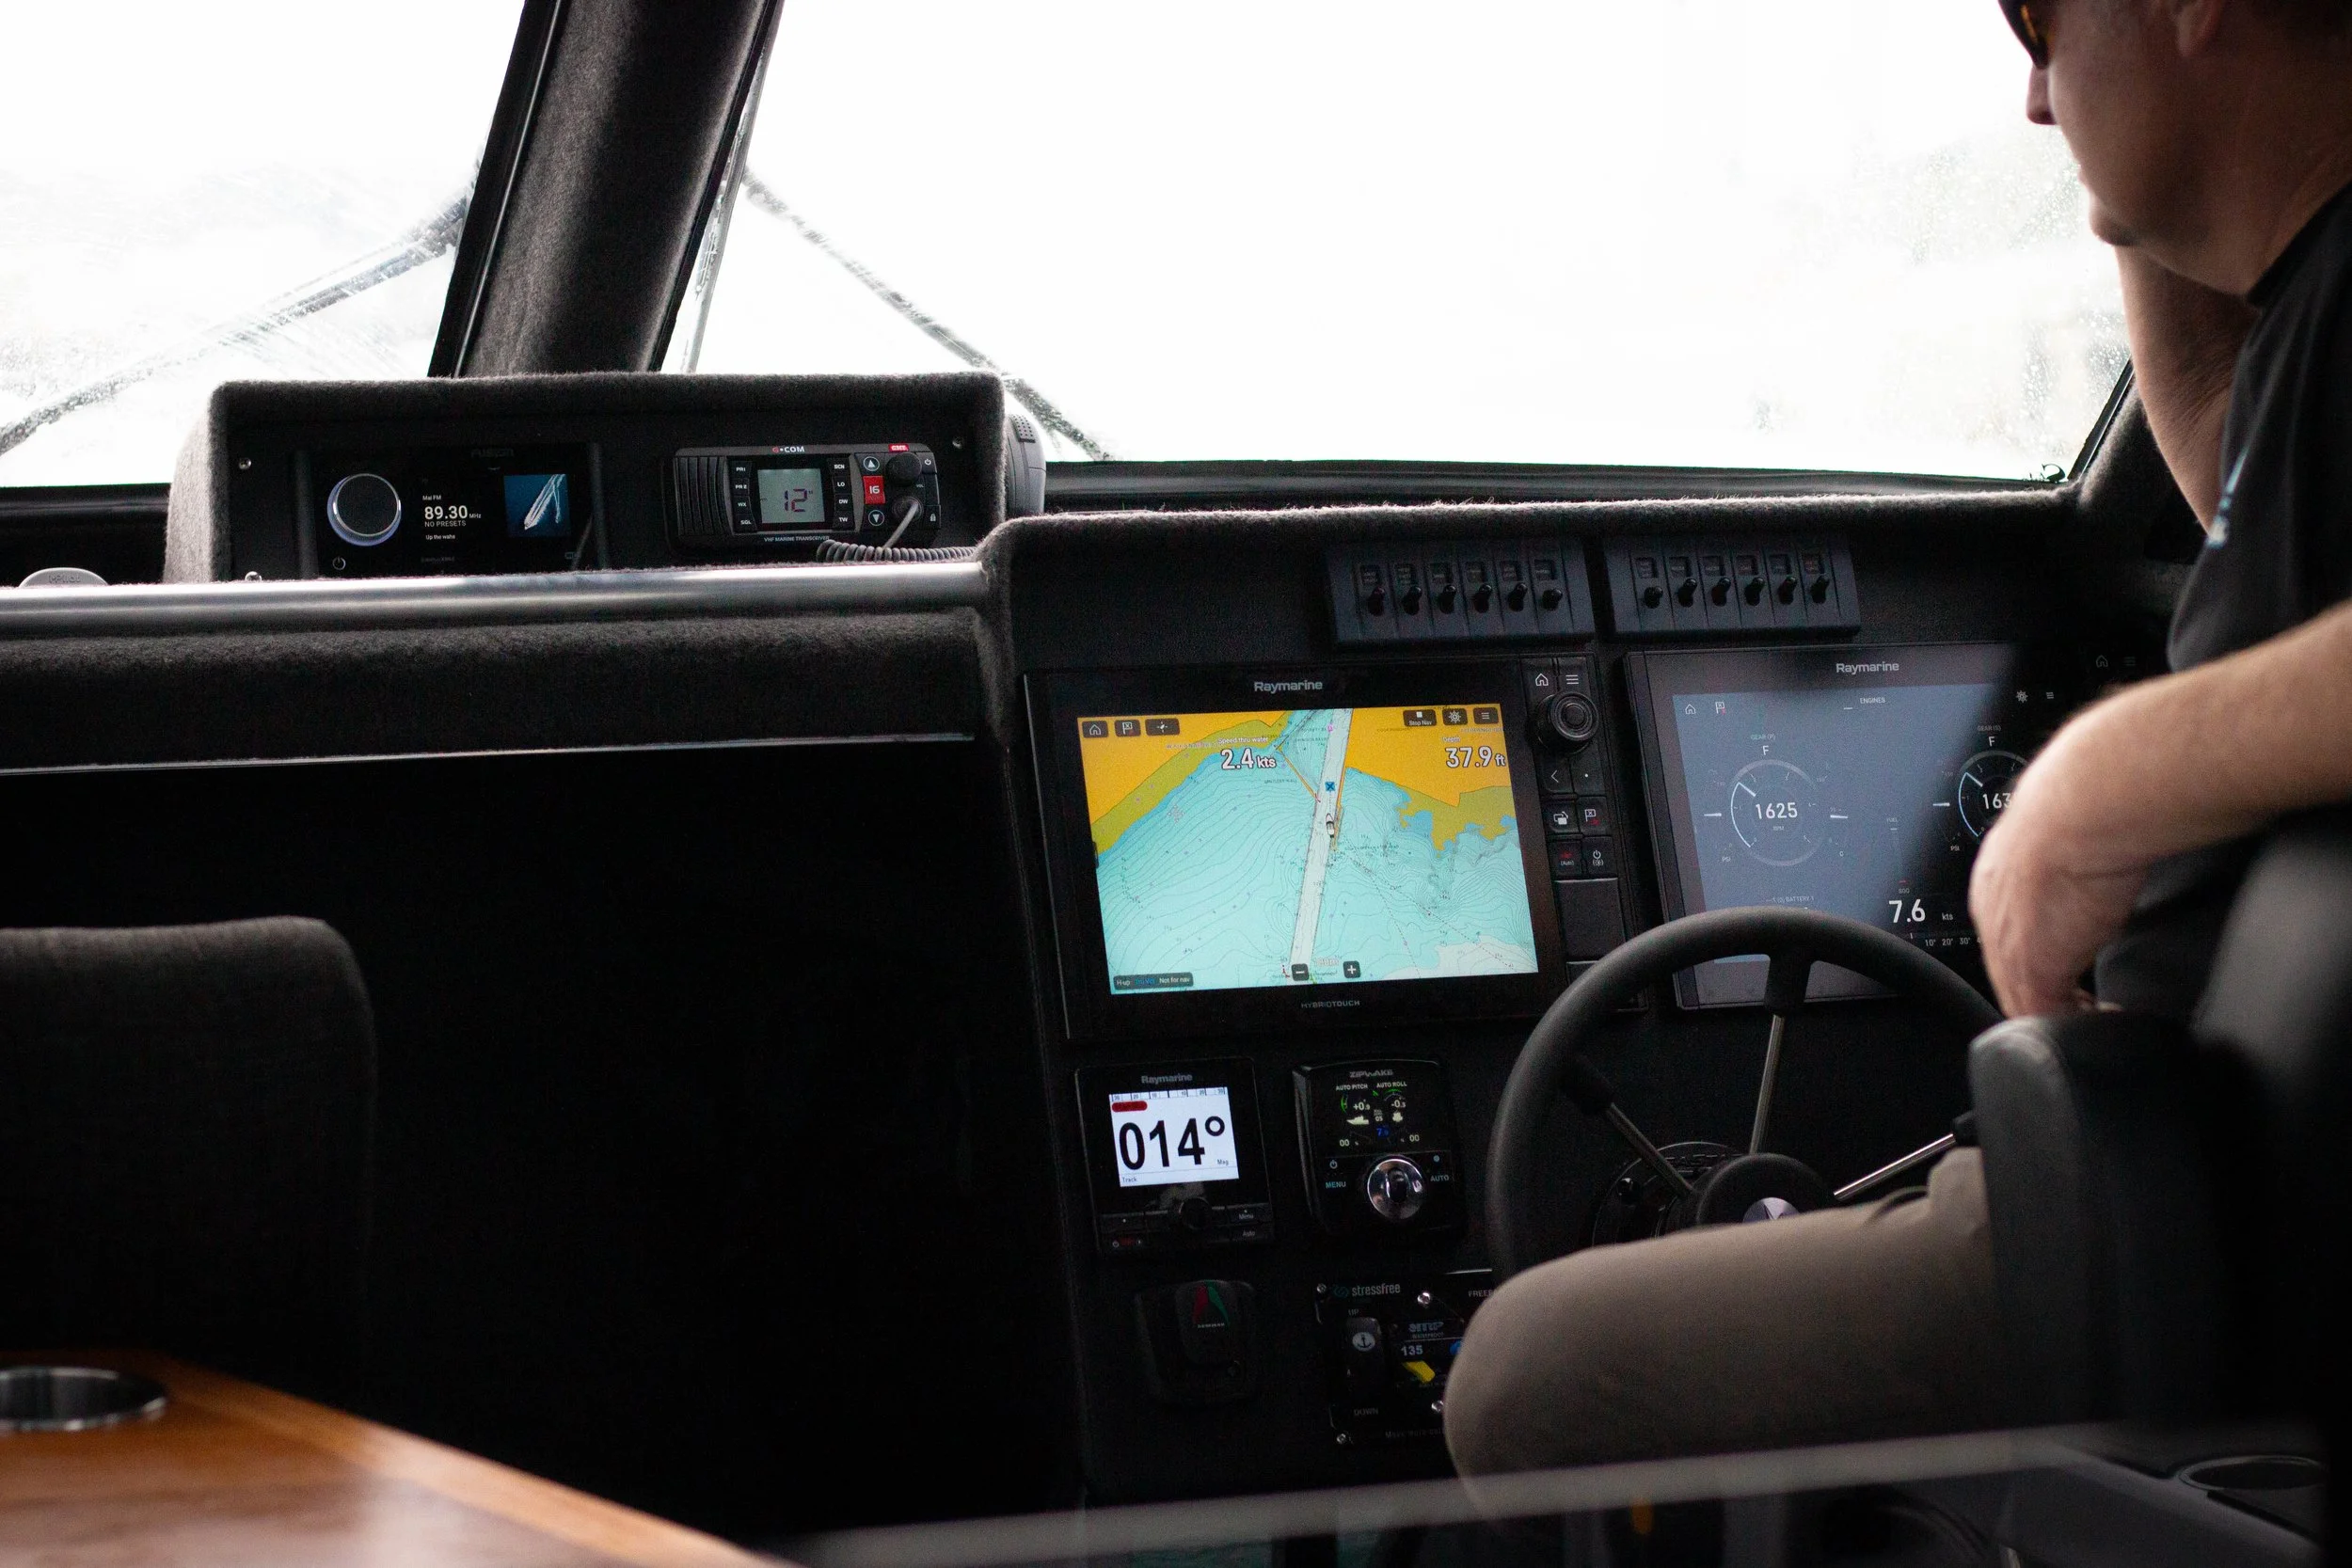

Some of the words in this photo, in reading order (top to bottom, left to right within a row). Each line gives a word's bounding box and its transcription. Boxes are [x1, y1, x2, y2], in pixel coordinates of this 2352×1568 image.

[869, 485, 880, 494] 16
[784, 488, 807, 513] 12
[424, 505, 469, 521] 89.30
[1836, 661, 1899, 675] Raymarine
[1253, 680, 1324, 694] Raymarine
[1988, 736, 1995, 747] F
[1444, 745, 1492, 768] 37.9
[1494, 753, 1506, 767] ft
[1762, 745, 1769, 755] F
[1220, 747, 1255, 770] 2.4
[1256, 754, 1277, 768] kts
[1982, 792, 2011, 810] 163
[1756, 801, 1798, 819] 1625
[1888, 898, 1926, 924] 7.6
[1941, 912, 1954, 921] kts
[1942, 938, 1953, 946] 20°
[1300, 1000, 1361, 1009] HYBRIDTOUCH
[1140, 1073, 1194, 1085] Raymarine
[1119, 1116, 1226, 1170] 014°
[1339, 1139, 1350, 1148] 00
[1430, 1174, 1450, 1182] AUTO
[1351, 1282, 1401, 1297] stressfree
[1400, 1344, 1423, 1356] 135
[1353, 1407, 1379, 1417] DOWN
